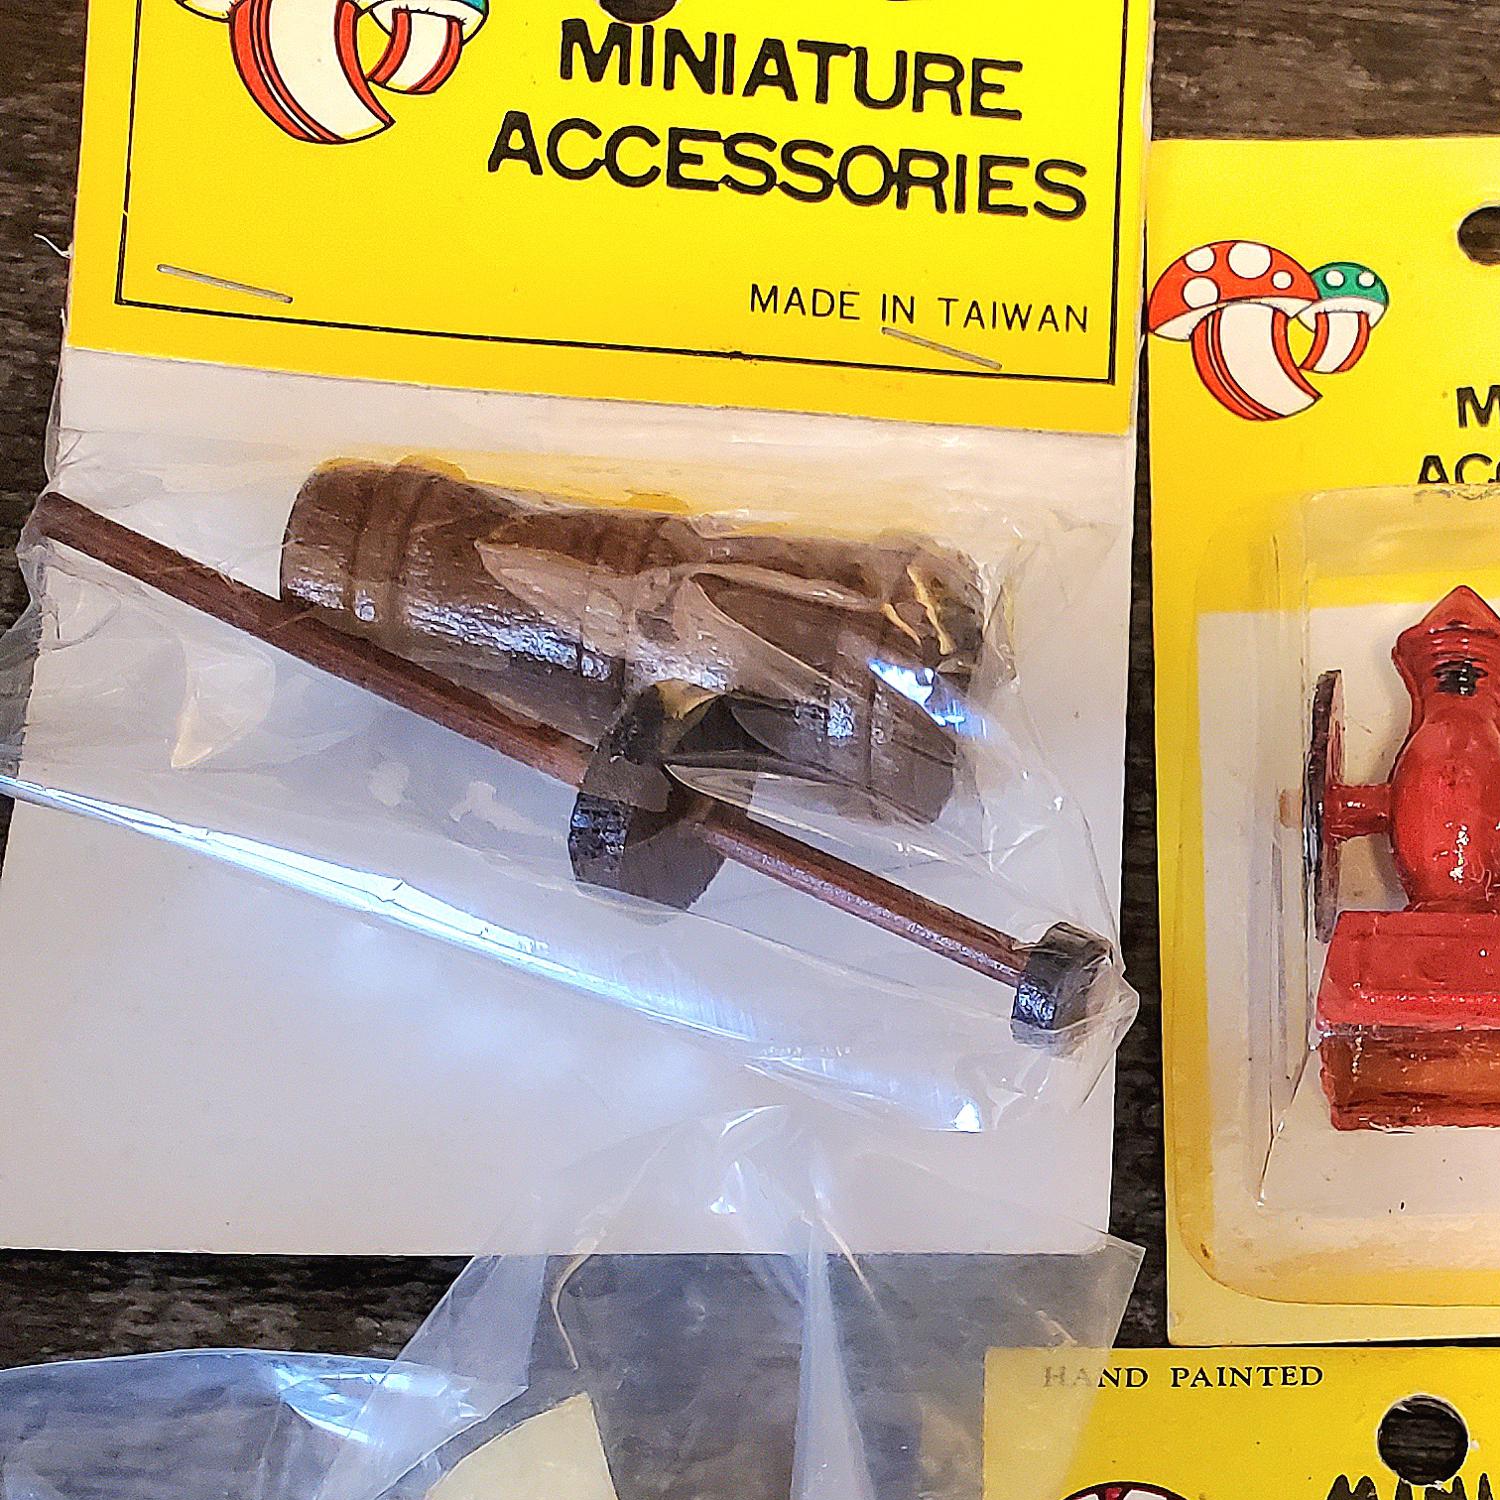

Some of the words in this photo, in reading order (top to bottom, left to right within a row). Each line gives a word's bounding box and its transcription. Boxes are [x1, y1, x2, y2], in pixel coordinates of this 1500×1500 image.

[558, 18, 1023, 121] MINIATURE
[487, 110, 1088, 221] ACCESSORIES
[750, 283, 861, 321] MADE
[881, 293, 915, 326] IN
[938, 297, 1089, 334] TAIWAN
[1044, 1366, 1149, 1388] HAND
[1169, 1365, 1324, 1388] PAINTED
